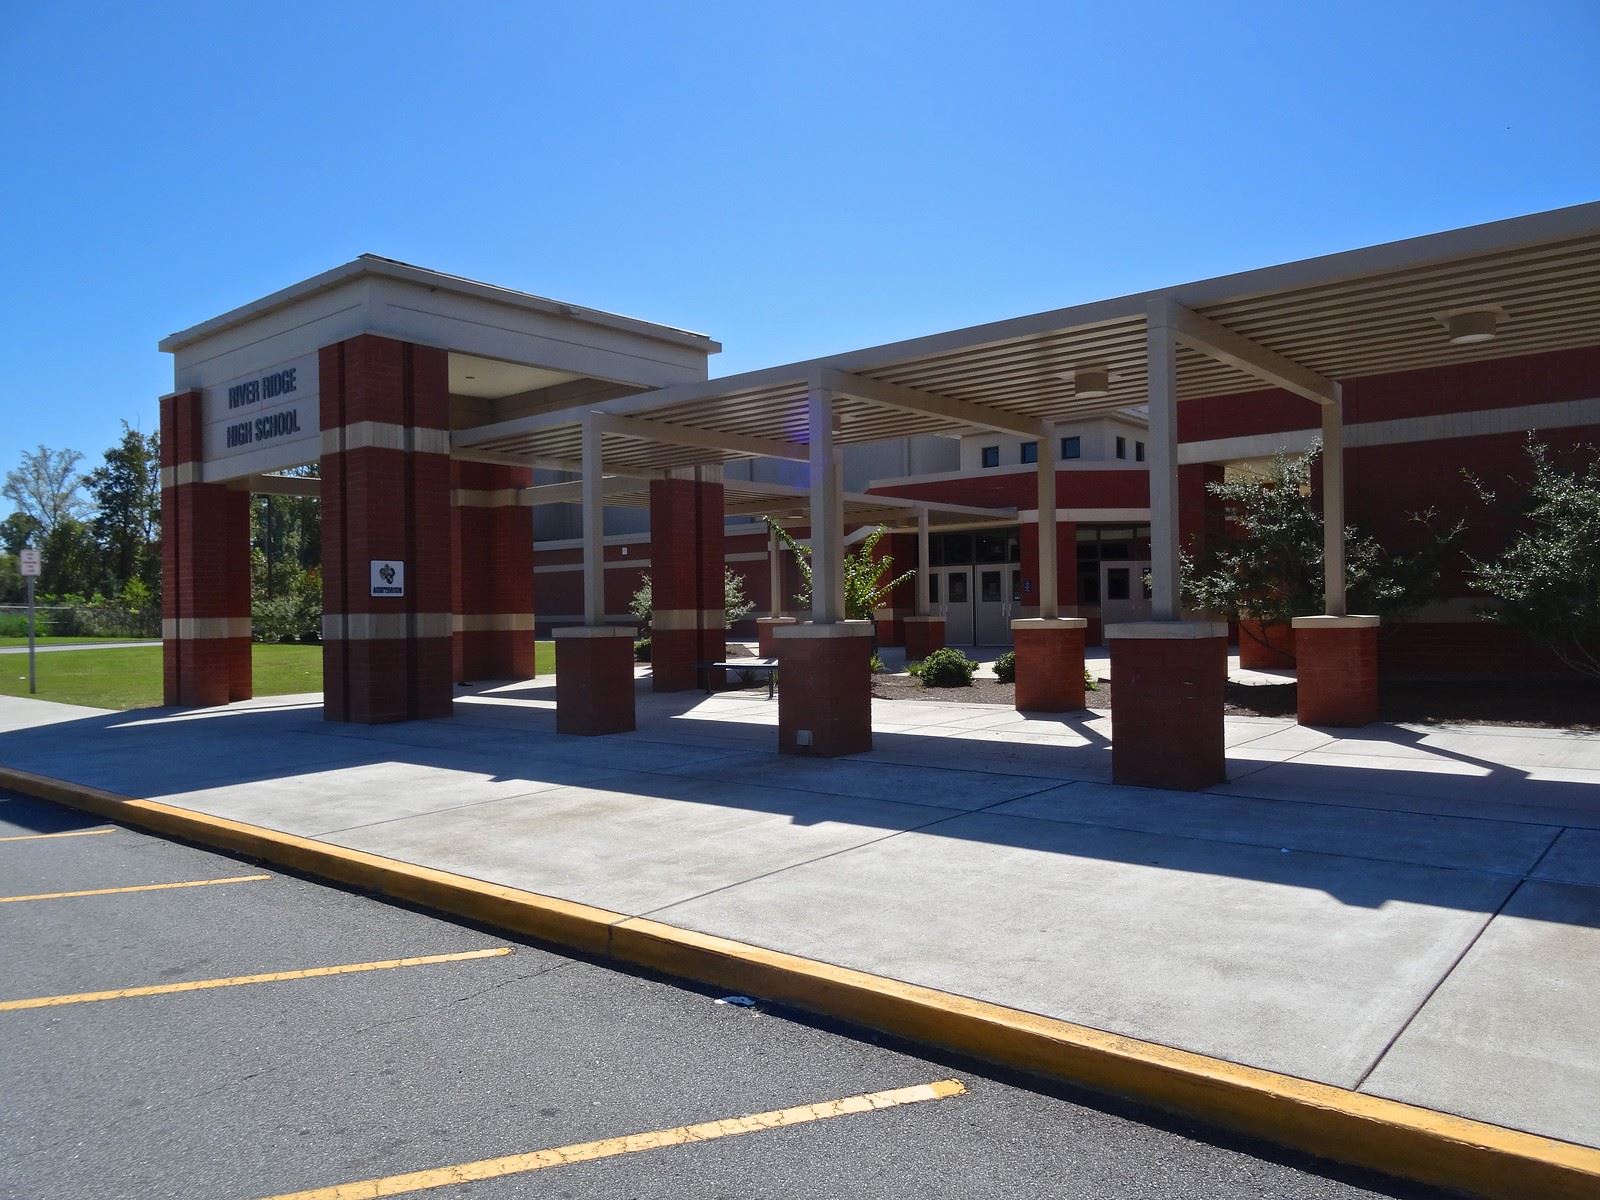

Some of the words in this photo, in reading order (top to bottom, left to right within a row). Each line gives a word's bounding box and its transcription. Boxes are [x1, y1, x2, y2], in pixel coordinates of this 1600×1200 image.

[228, 380, 260, 410] RIVER
[262, 367, 297, 400] RIDGE
[226, 421, 253, 449] HIGH
[255, 409, 300, 442] SCHOOL
